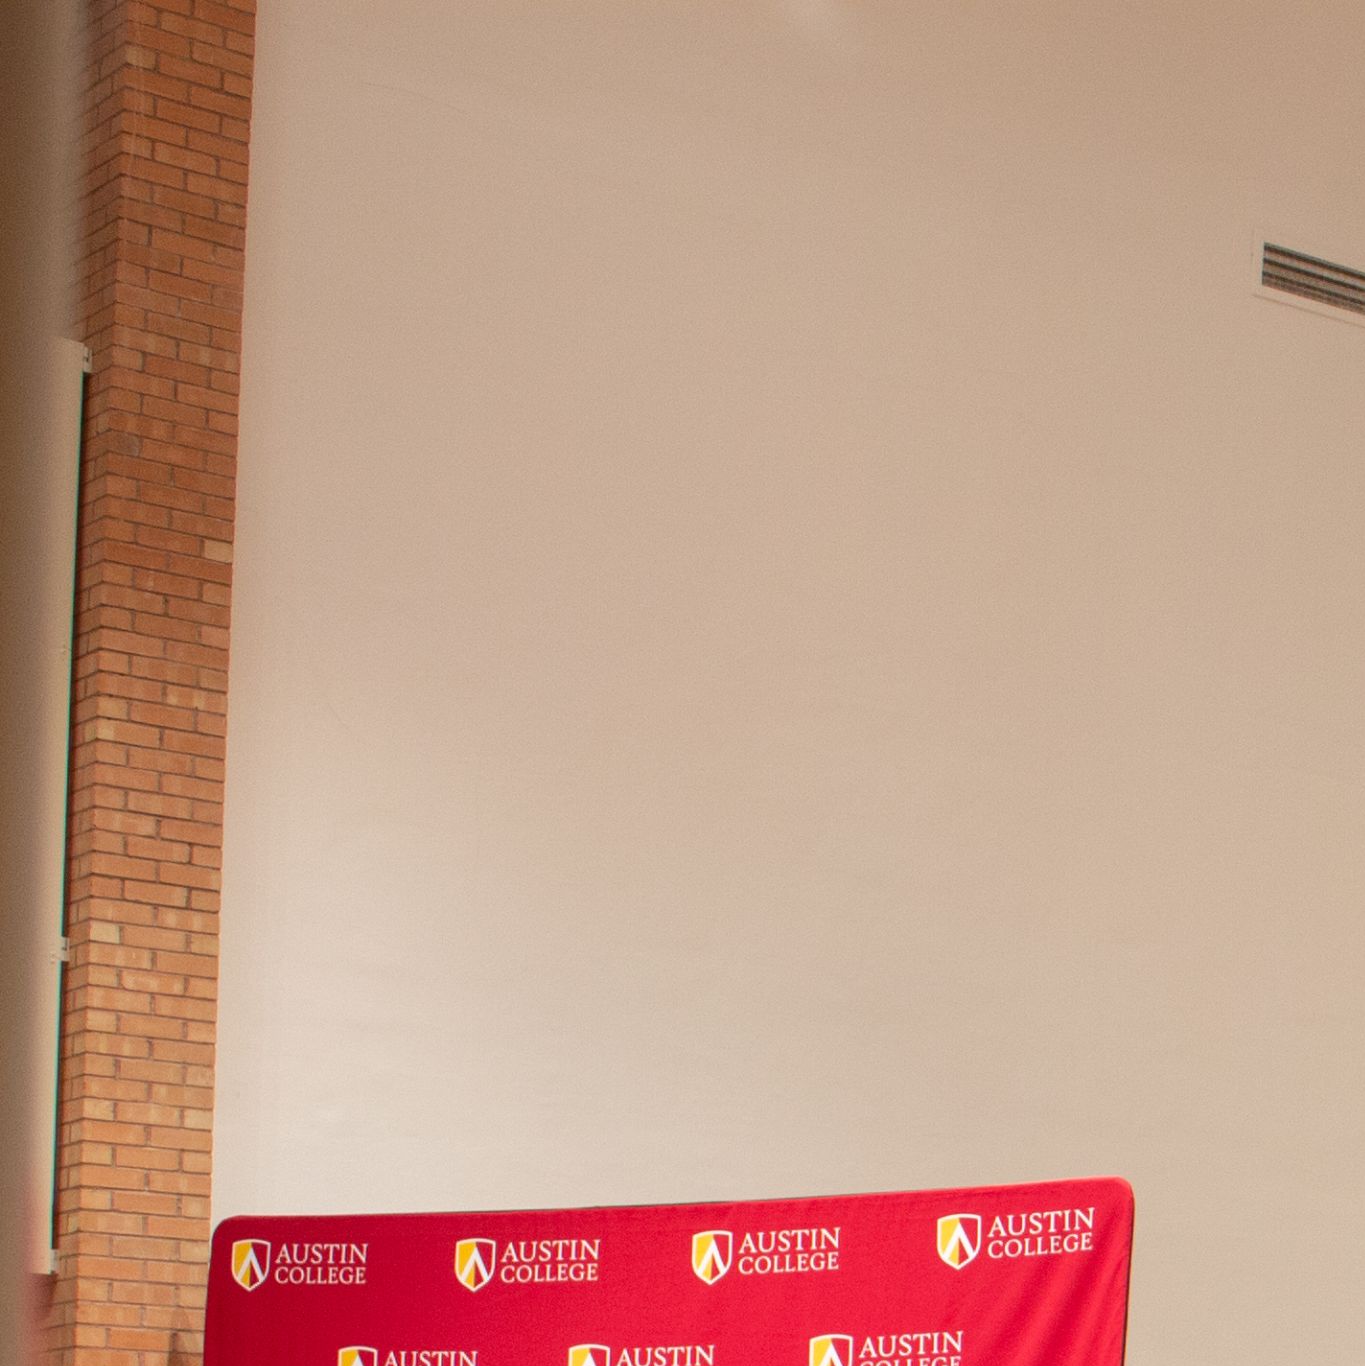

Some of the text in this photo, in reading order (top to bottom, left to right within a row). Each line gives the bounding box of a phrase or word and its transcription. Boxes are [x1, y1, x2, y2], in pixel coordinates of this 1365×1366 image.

[987, 1207, 1095, 1238] AUSTIN
[501, 1239, 601, 1263] AUSTIN
[738, 1226, 841, 1254] AUSTIN
[987, 1231, 1093, 1259] COLLEGE
[275, 1243, 368, 1265] AUSTIN
[738, 1251, 839, 1275] COLLEGE
[274, 1266, 366, 1285] COLLEGE
[500, 1262, 598, 1284] COLLEGE
[858, 1330, 963, 1359] AUSTIN
